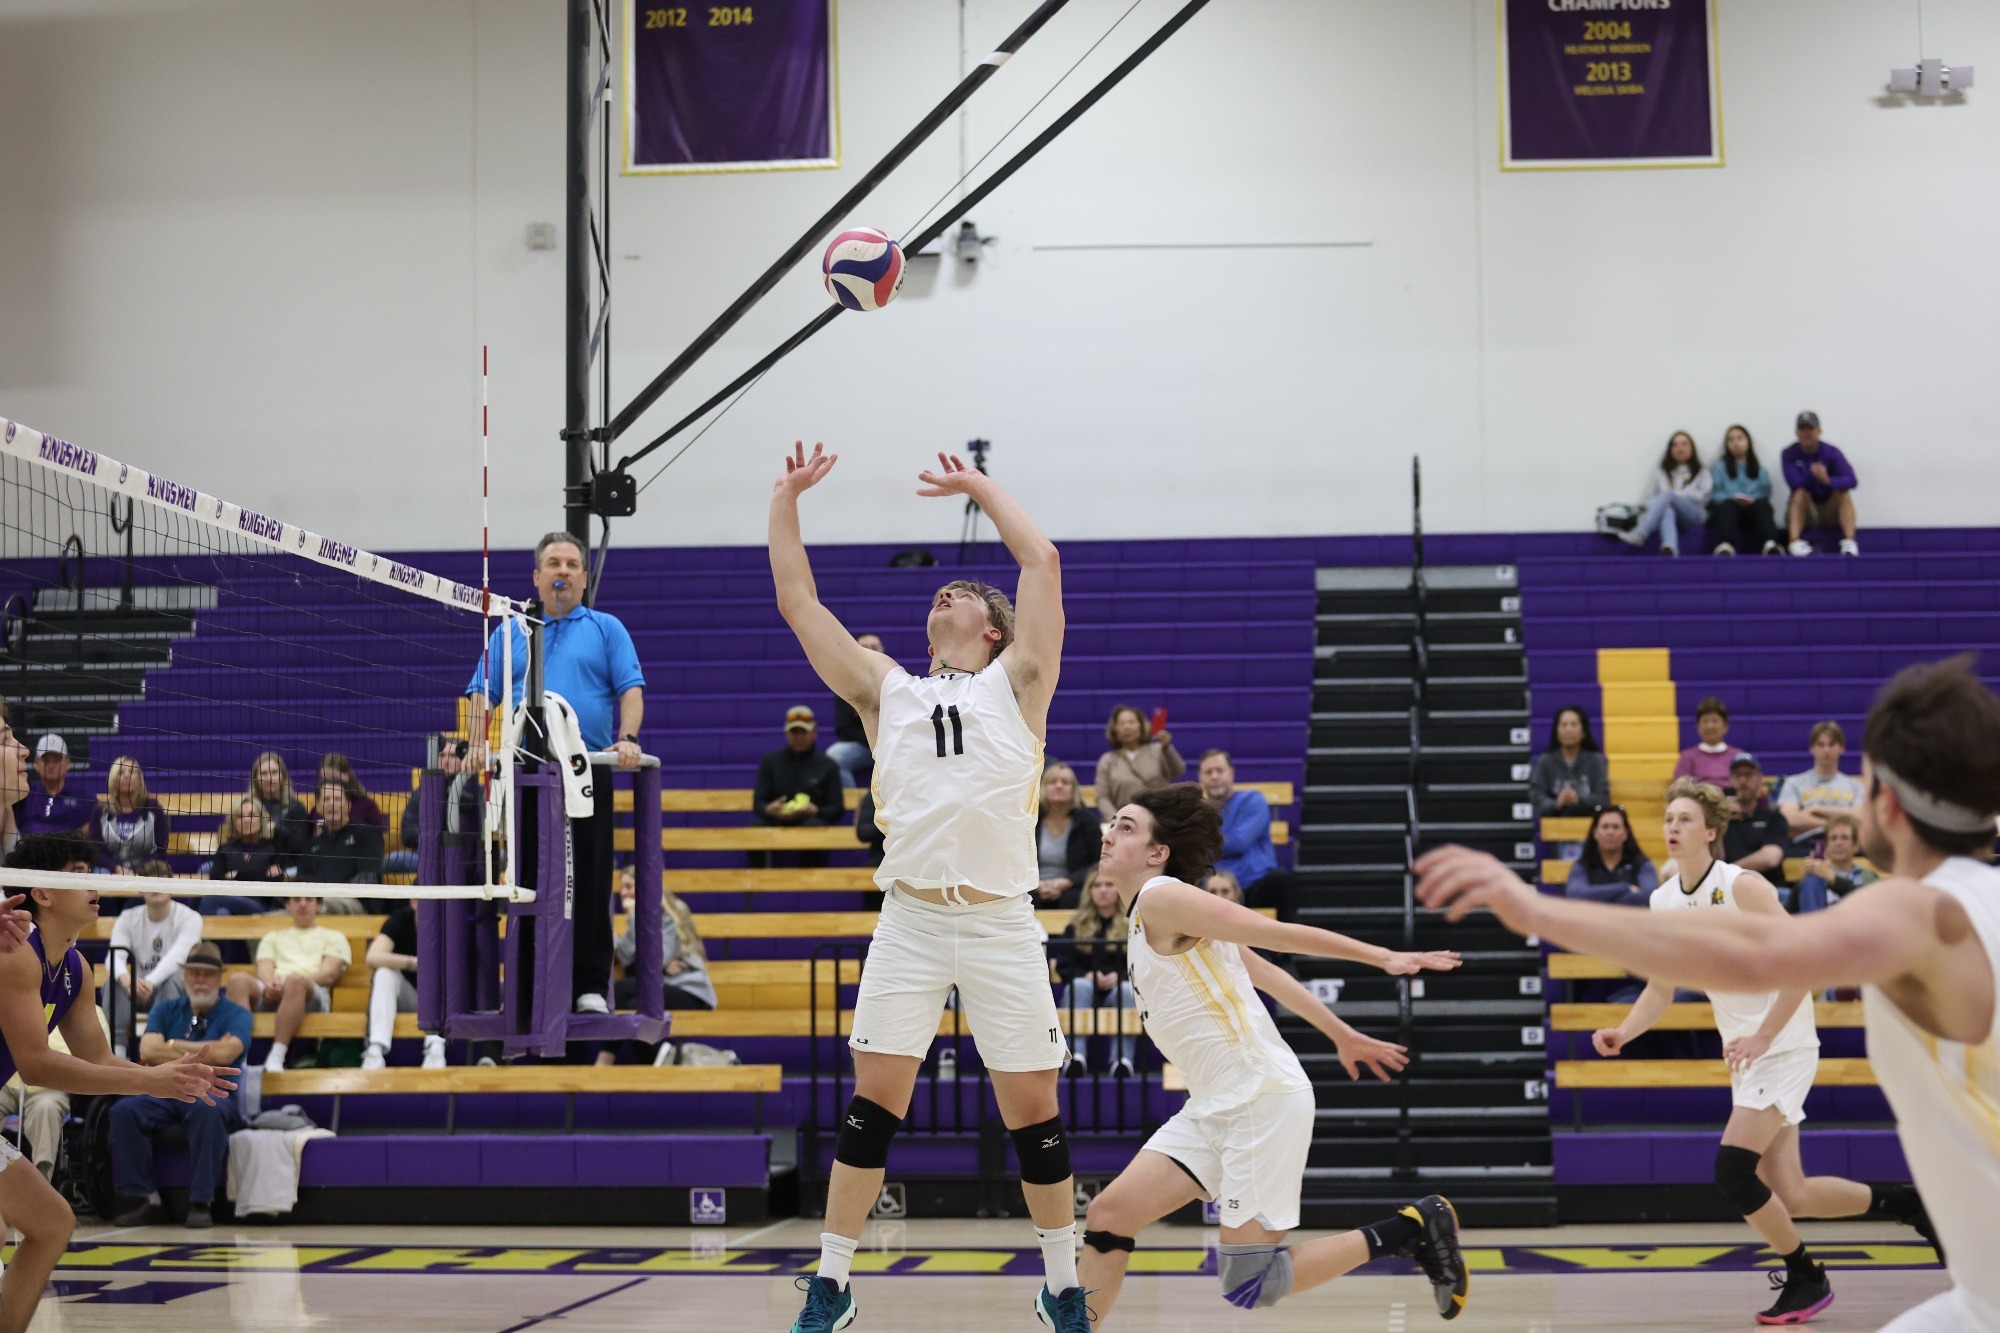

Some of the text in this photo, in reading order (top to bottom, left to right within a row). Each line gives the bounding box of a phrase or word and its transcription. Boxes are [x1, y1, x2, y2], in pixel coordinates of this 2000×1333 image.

[645, 7, 753, 28] 2012 2014
[1547, 0, 1672, 12] CHAMPIONS
[1583, 21, 1632, 41] 2004
[1586, 61, 1632, 81] 2013
[39, 432, 98, 476] KINGSMEN
[147, 473, 198, 512] KINGSMEN
[239, 507, 283, 542] KINGSMEN
[318, 536, 358, 567] KINGSMEN
[389, 561, 425, 589] KINGSMEN
[931, 704, 964, 758] 11
[1048, 1027, 1058, 1044] 11
[1228, 1199, 1240, 1209] 25
